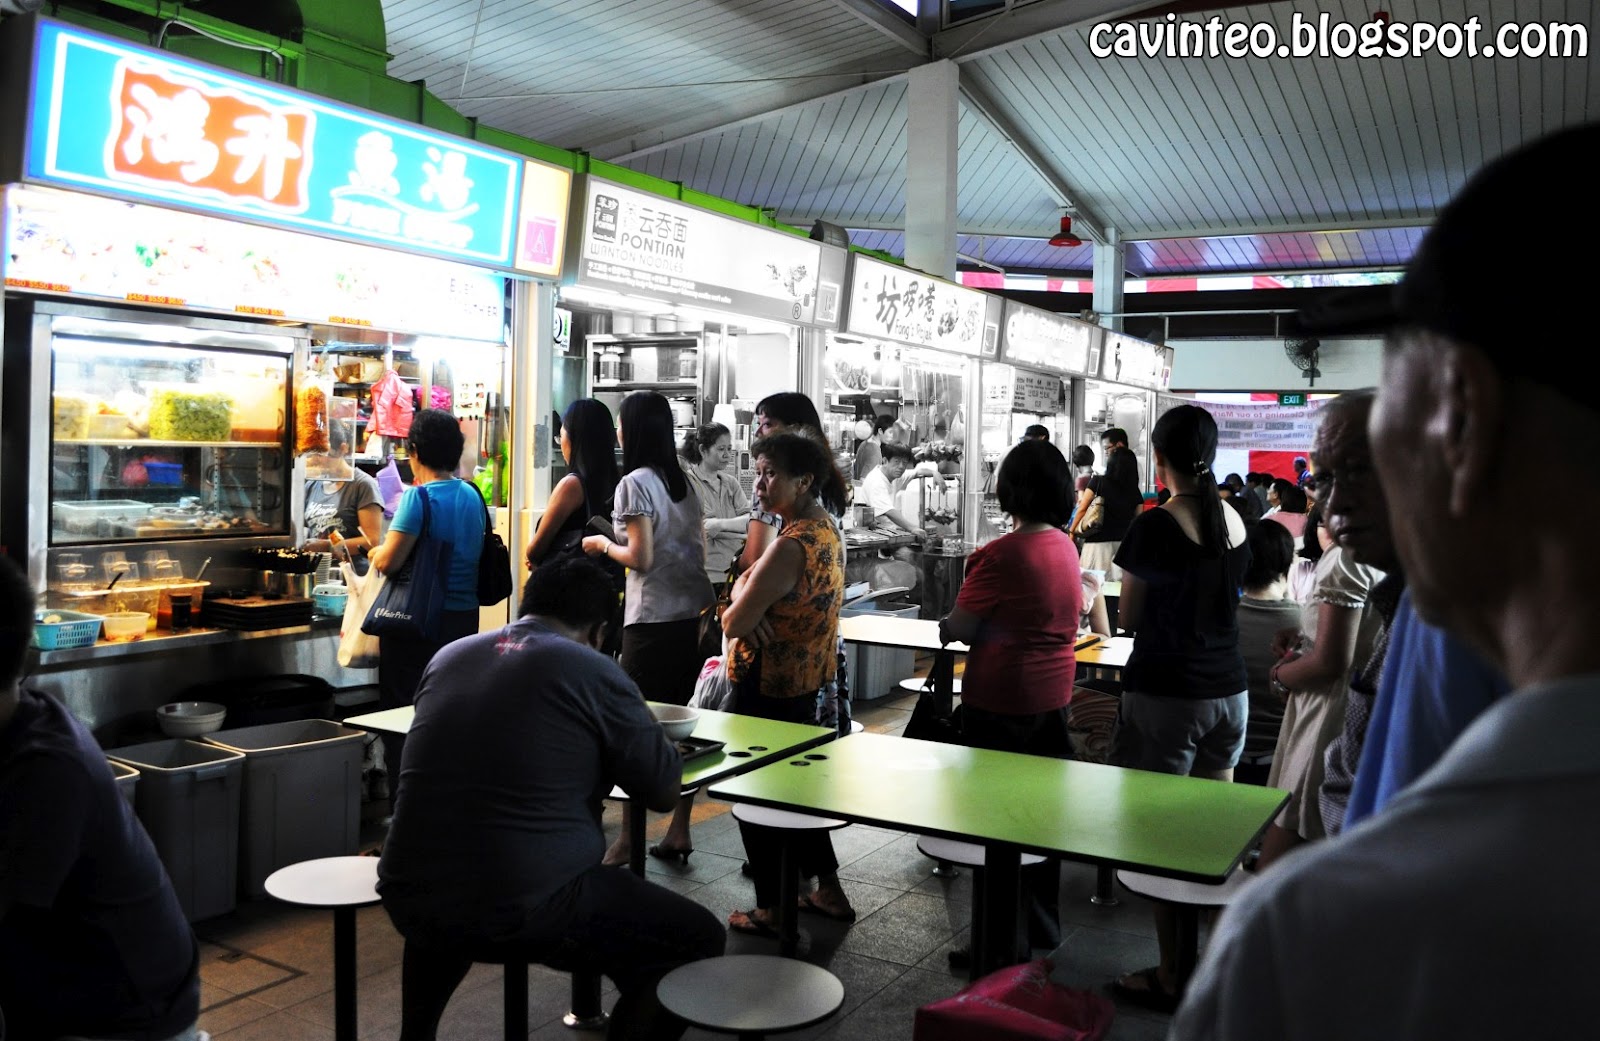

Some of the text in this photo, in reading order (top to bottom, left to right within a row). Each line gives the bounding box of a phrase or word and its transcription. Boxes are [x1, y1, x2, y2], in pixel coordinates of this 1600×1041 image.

[620, 232, 685, 260] PONTIAN
[590, 242, 684, 274] WANTON NOODLES
[1283, 395, 1300, 404] EXIT
[382, 609, 412, 620] FairPrice
